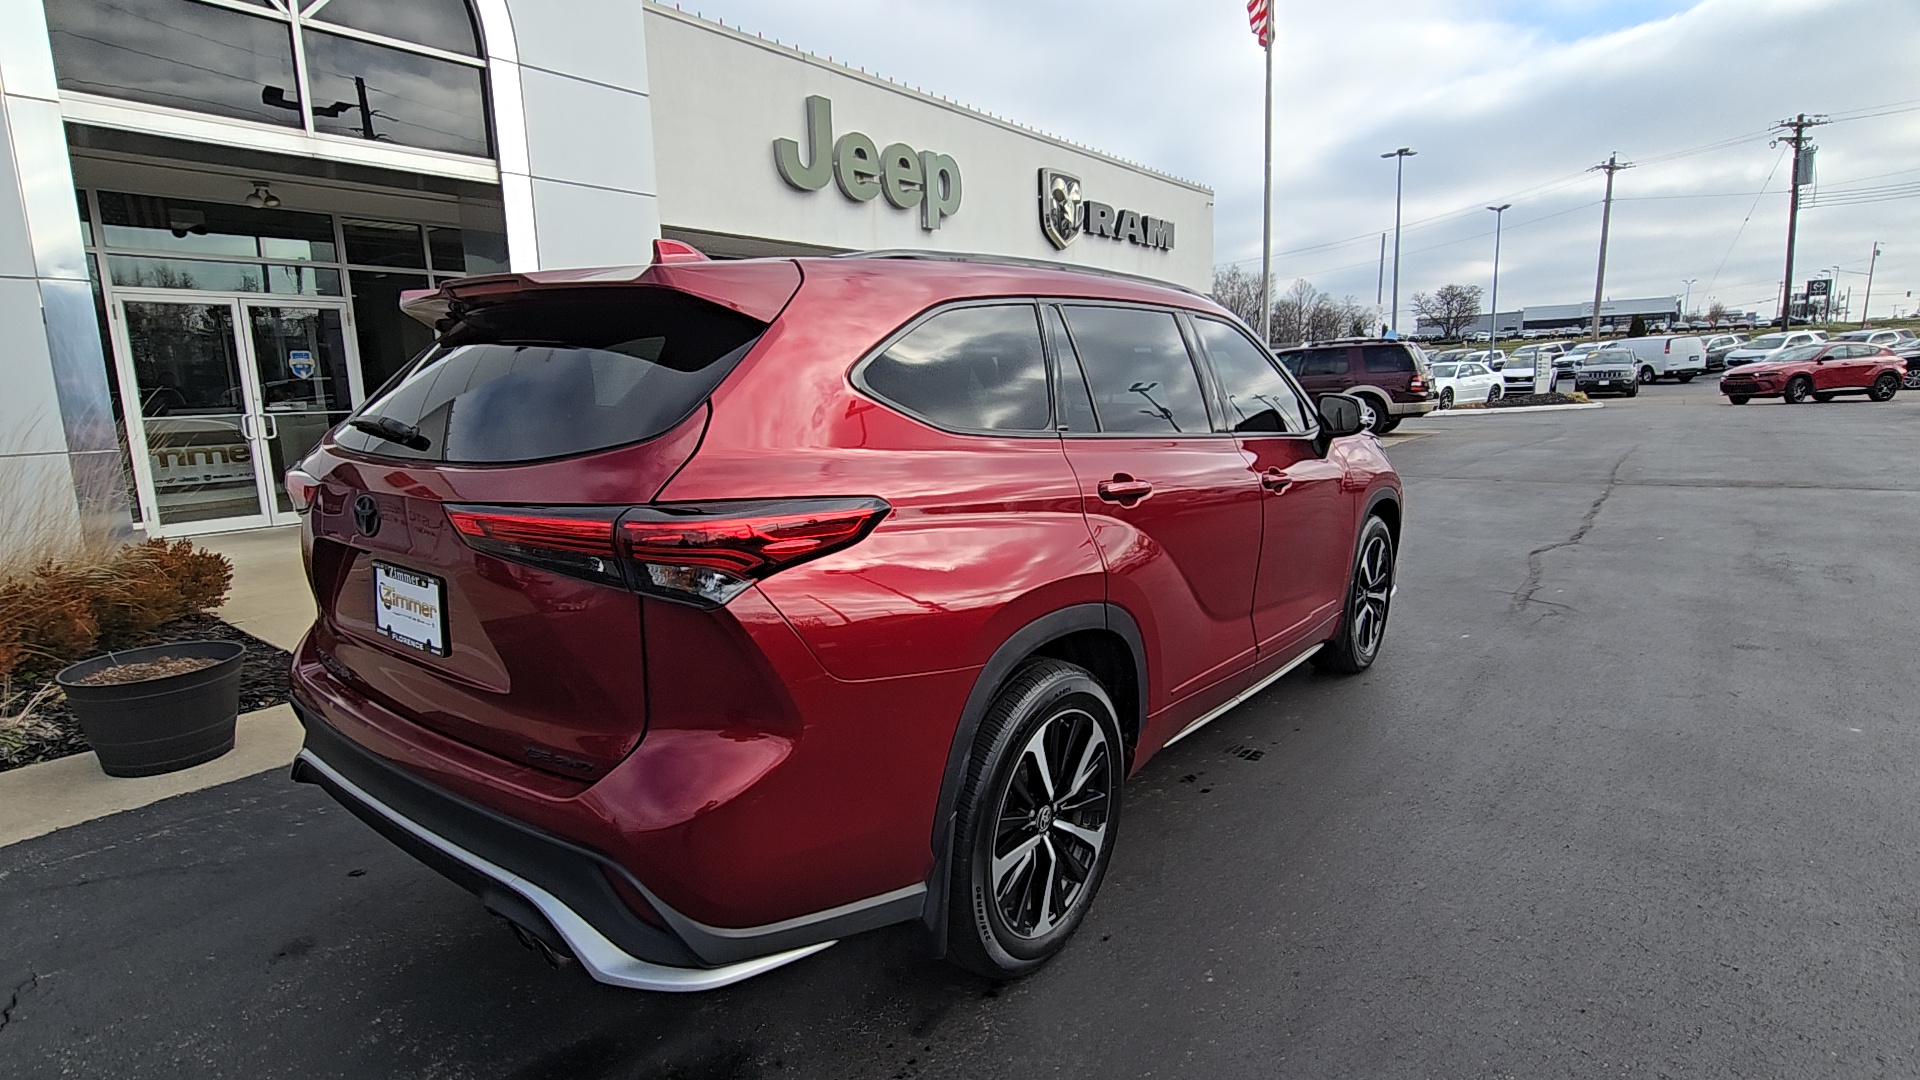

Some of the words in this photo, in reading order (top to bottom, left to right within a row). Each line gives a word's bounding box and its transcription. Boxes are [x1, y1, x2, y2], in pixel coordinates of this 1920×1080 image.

[773, 95, 962, 231] Jeep
[1084, 200, 1175, 251] RAM
[388, 566, 420, 586] Zimmer
[382, 585, 437, 619] Zimmer
[391, 633, 424, 651] FLORENCE
